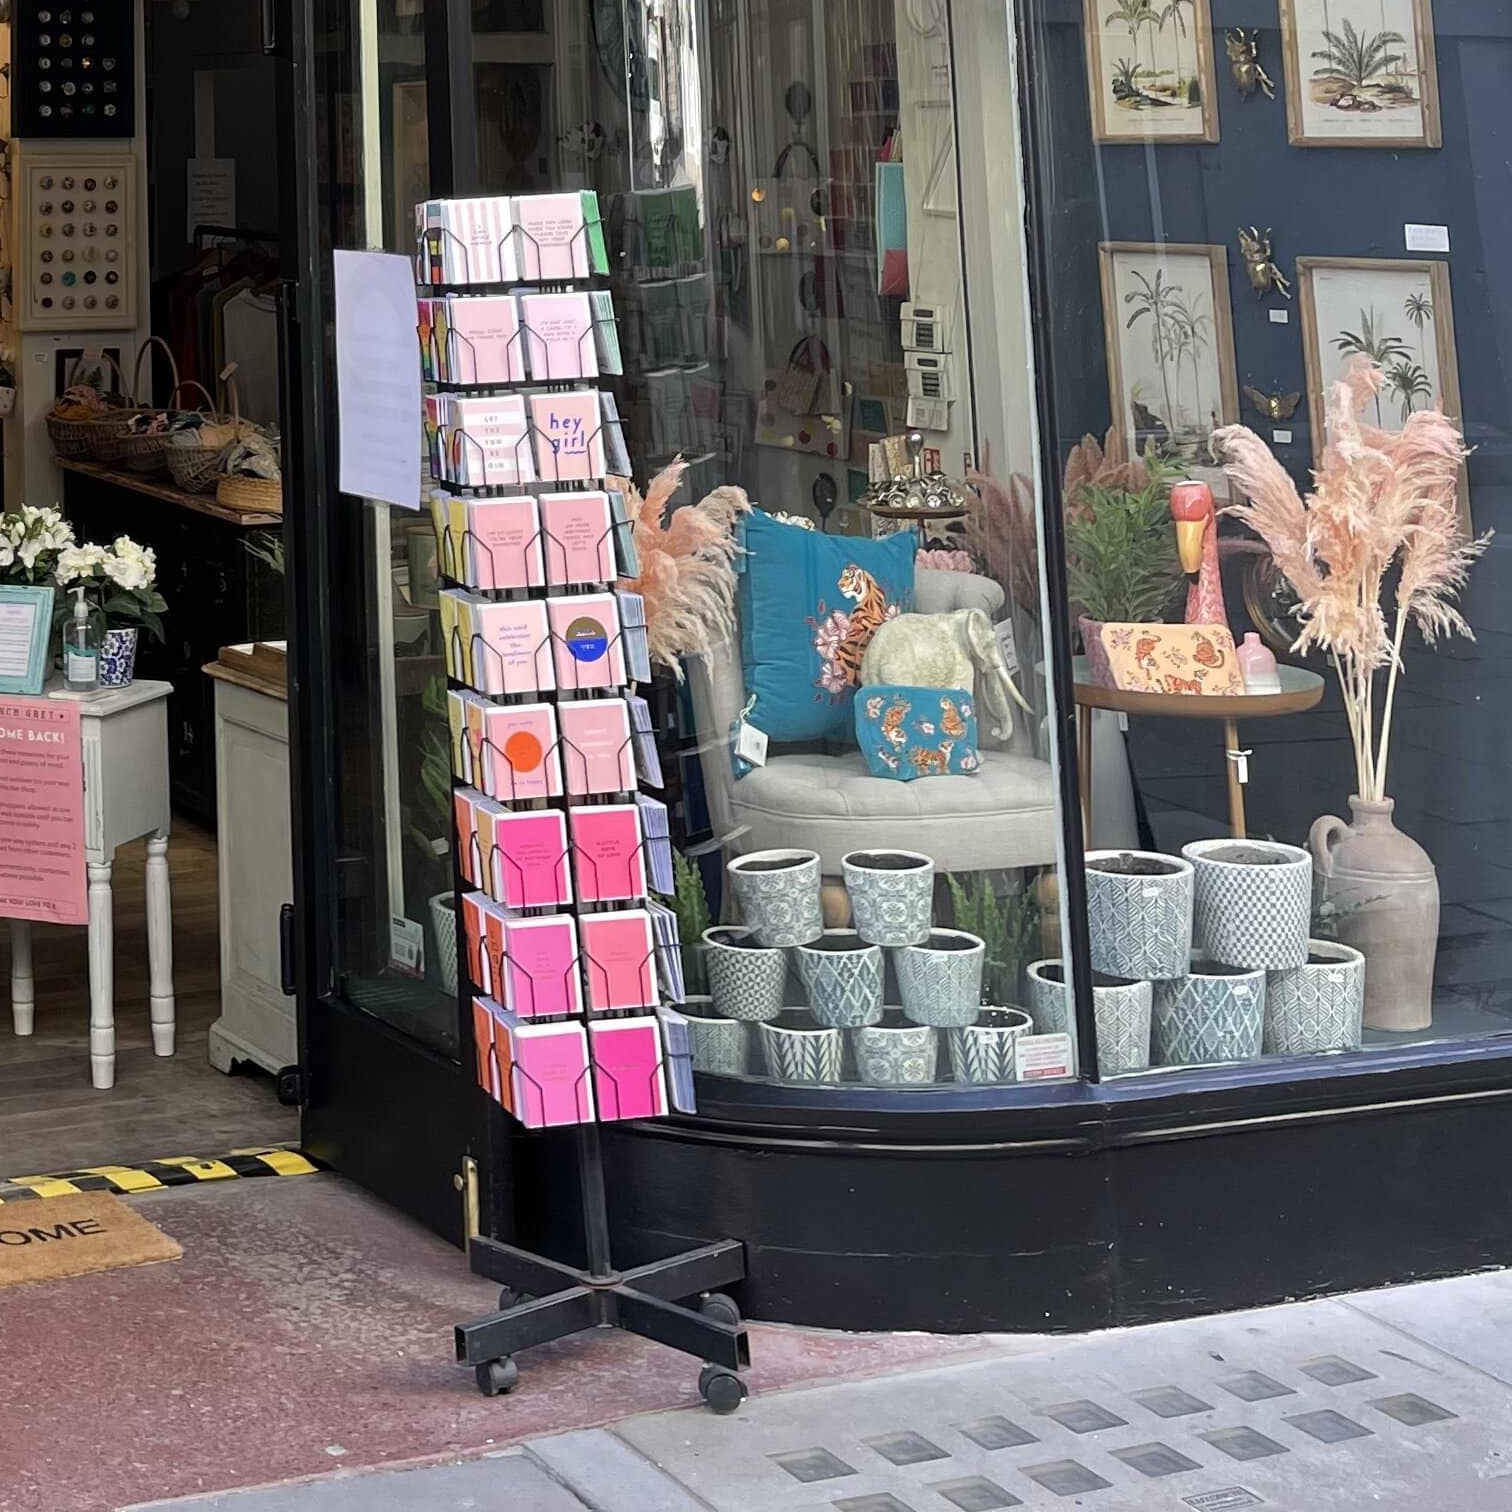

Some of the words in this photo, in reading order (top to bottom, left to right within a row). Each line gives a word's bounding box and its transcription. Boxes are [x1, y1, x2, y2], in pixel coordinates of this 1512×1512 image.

[550, 412, 582, 434] hey
[551, 430, 585, 454] girl
[27, 729, 65, 744] BACK!
